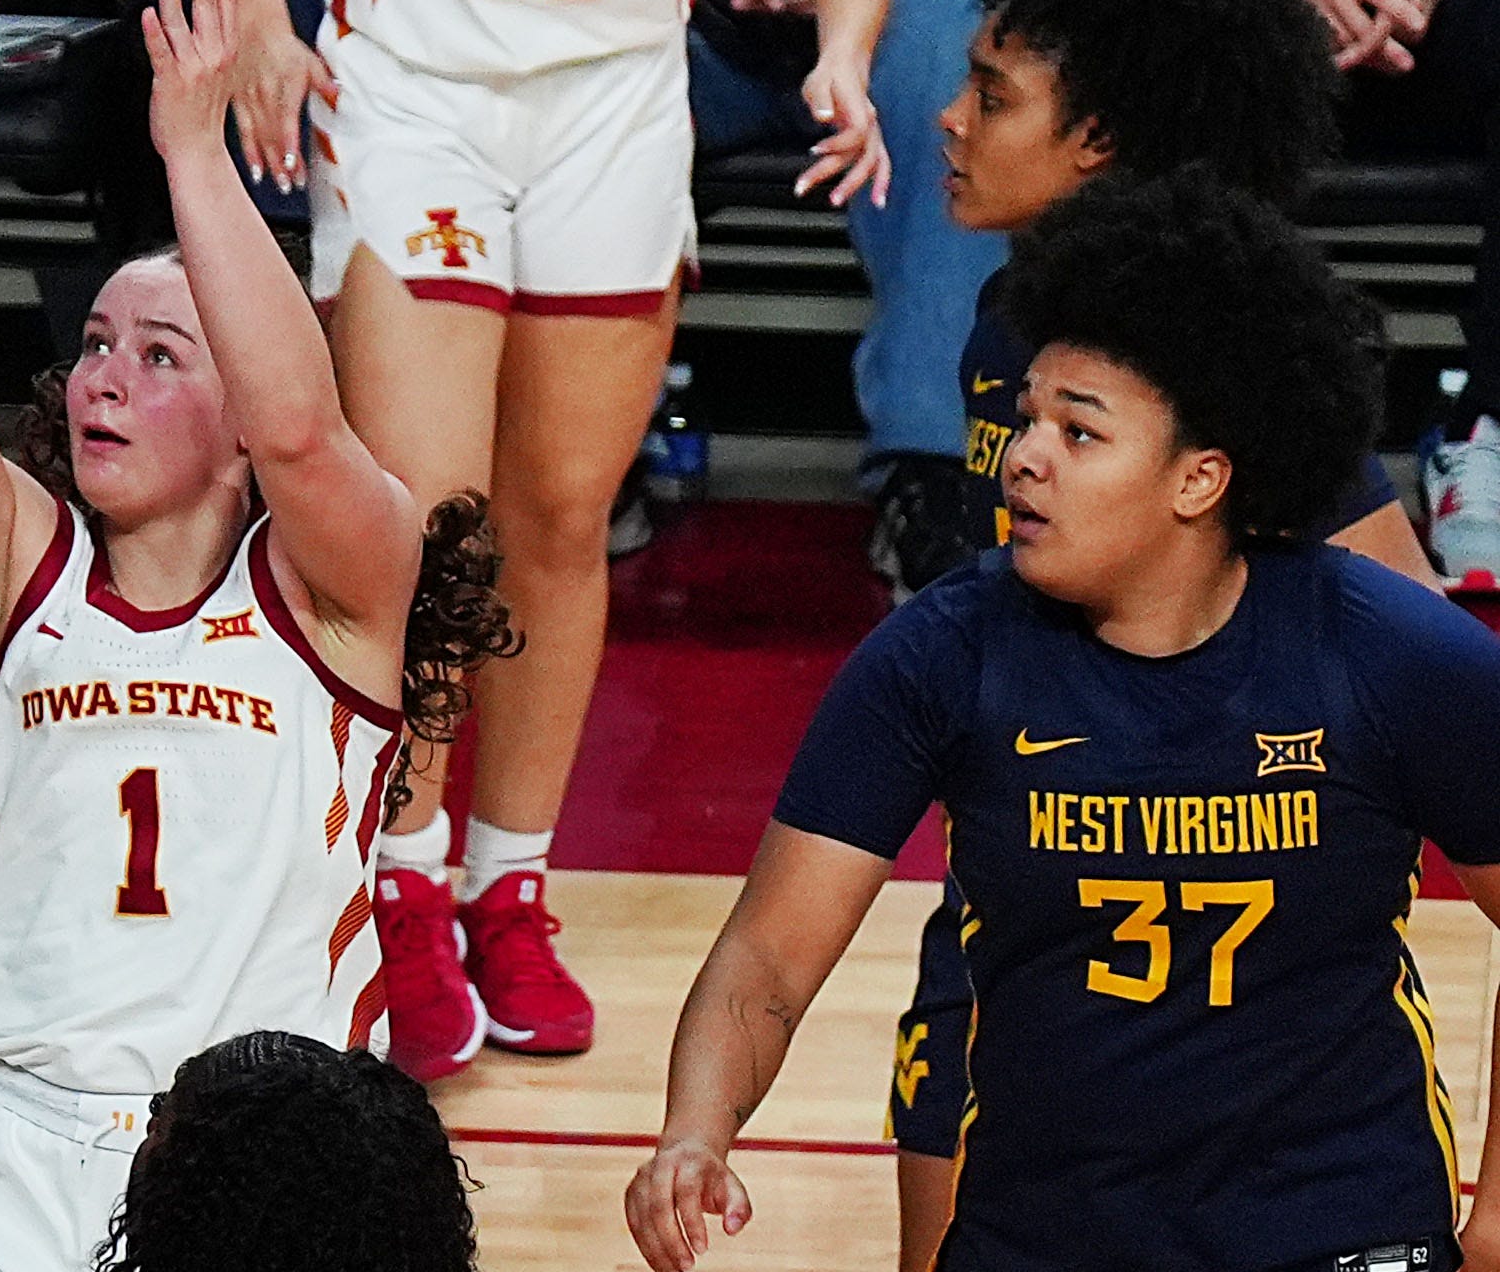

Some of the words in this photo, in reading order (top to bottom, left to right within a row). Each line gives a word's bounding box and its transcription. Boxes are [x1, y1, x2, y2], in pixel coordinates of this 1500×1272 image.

[966, 419, 1012, 478] EST
[21, 681, 119, 732] IOWA
[127, 681, 278, 736] STATE
[114, 766, 170, 918] 1
[1029, 790, 1130, 854] WEST
[1139, 789, 1319, 855] VIRGINIA
[1077, 878, 1275, 1007] 37
[1412, 1246, 1428, 1264] 52
